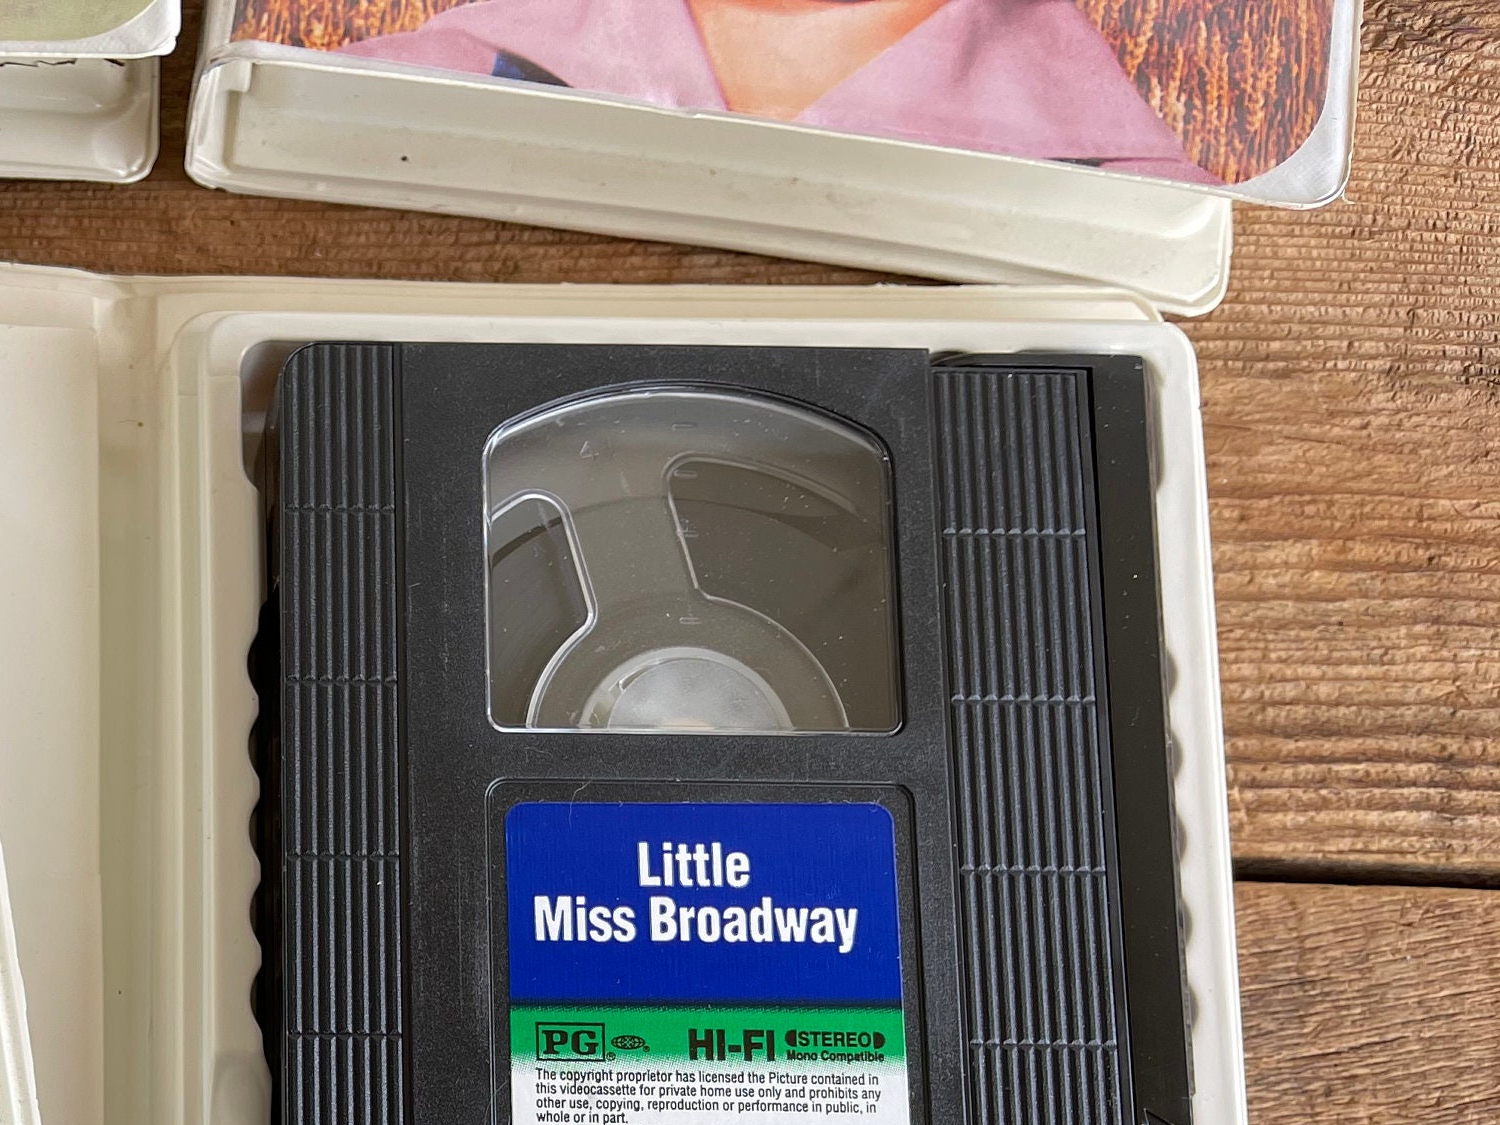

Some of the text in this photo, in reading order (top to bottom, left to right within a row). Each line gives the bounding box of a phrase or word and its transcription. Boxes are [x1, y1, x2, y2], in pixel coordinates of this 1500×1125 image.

[638, 842, 749, 887] Little
[534, 895, 857, 953] Miss Broadway
[541, 1029, 599, 1055] PG
[688, 1028, 871, 1061] HI-FI STEREO
[786, 1049, 884, 1063] Mono Compatible
[535, 1067, 878, 1085] The copyright proprietor has licensed the Picture contained in
[535, 1081, 881, 1101] this videocassette for private home use only and prohibits any
[536, 1096, 876, 1115] other use, copying, reproduction or performance in public, in
[536, 1110, 628, 1125] whole or in part.
